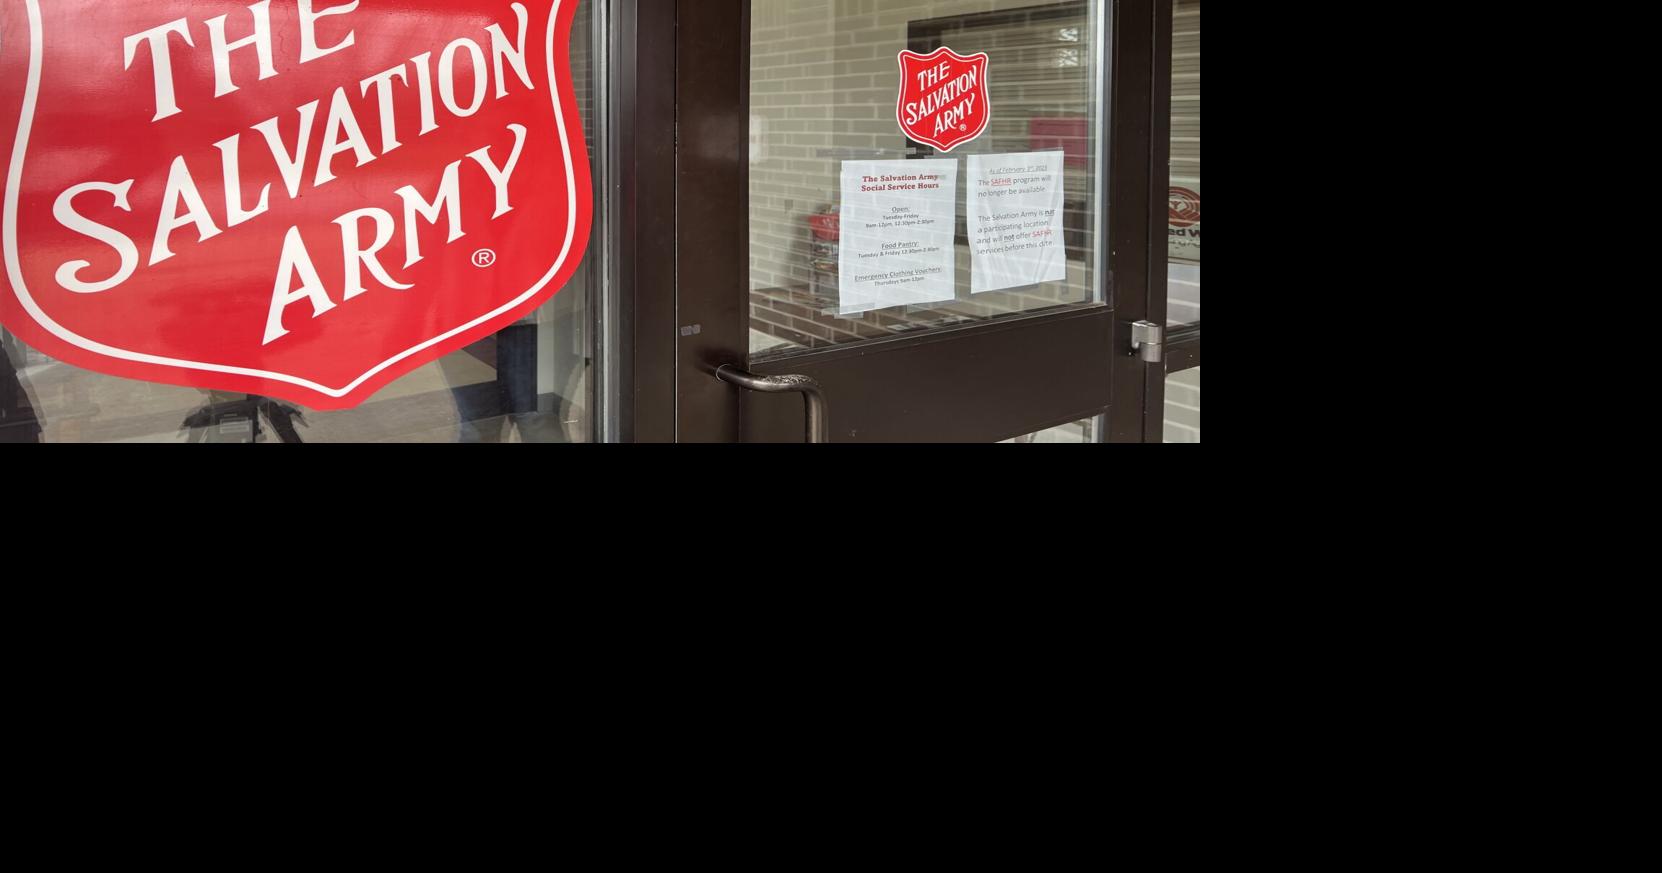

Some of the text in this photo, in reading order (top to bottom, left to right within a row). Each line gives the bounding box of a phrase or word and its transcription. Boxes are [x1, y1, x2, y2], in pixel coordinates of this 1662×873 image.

[124, 0, 359, 122] THE
[918, 61, 950, 92] THE
[906, 65, 977, 125] SALVATION
[933, 93, 975, 138] ARMY
[52, 2, 535, 294] SALVATION
[991, 178, 1012, 186] SAFHR
[262, 124, 527, 346] ARMY
[984, 223, 1022, 233] participating
[1004, 234, 1014, 242] not
[1005, 244, 1025, 252] before
[855, 273, 888, 281] Emergency
[890, 270, 914, 278] Clothing
